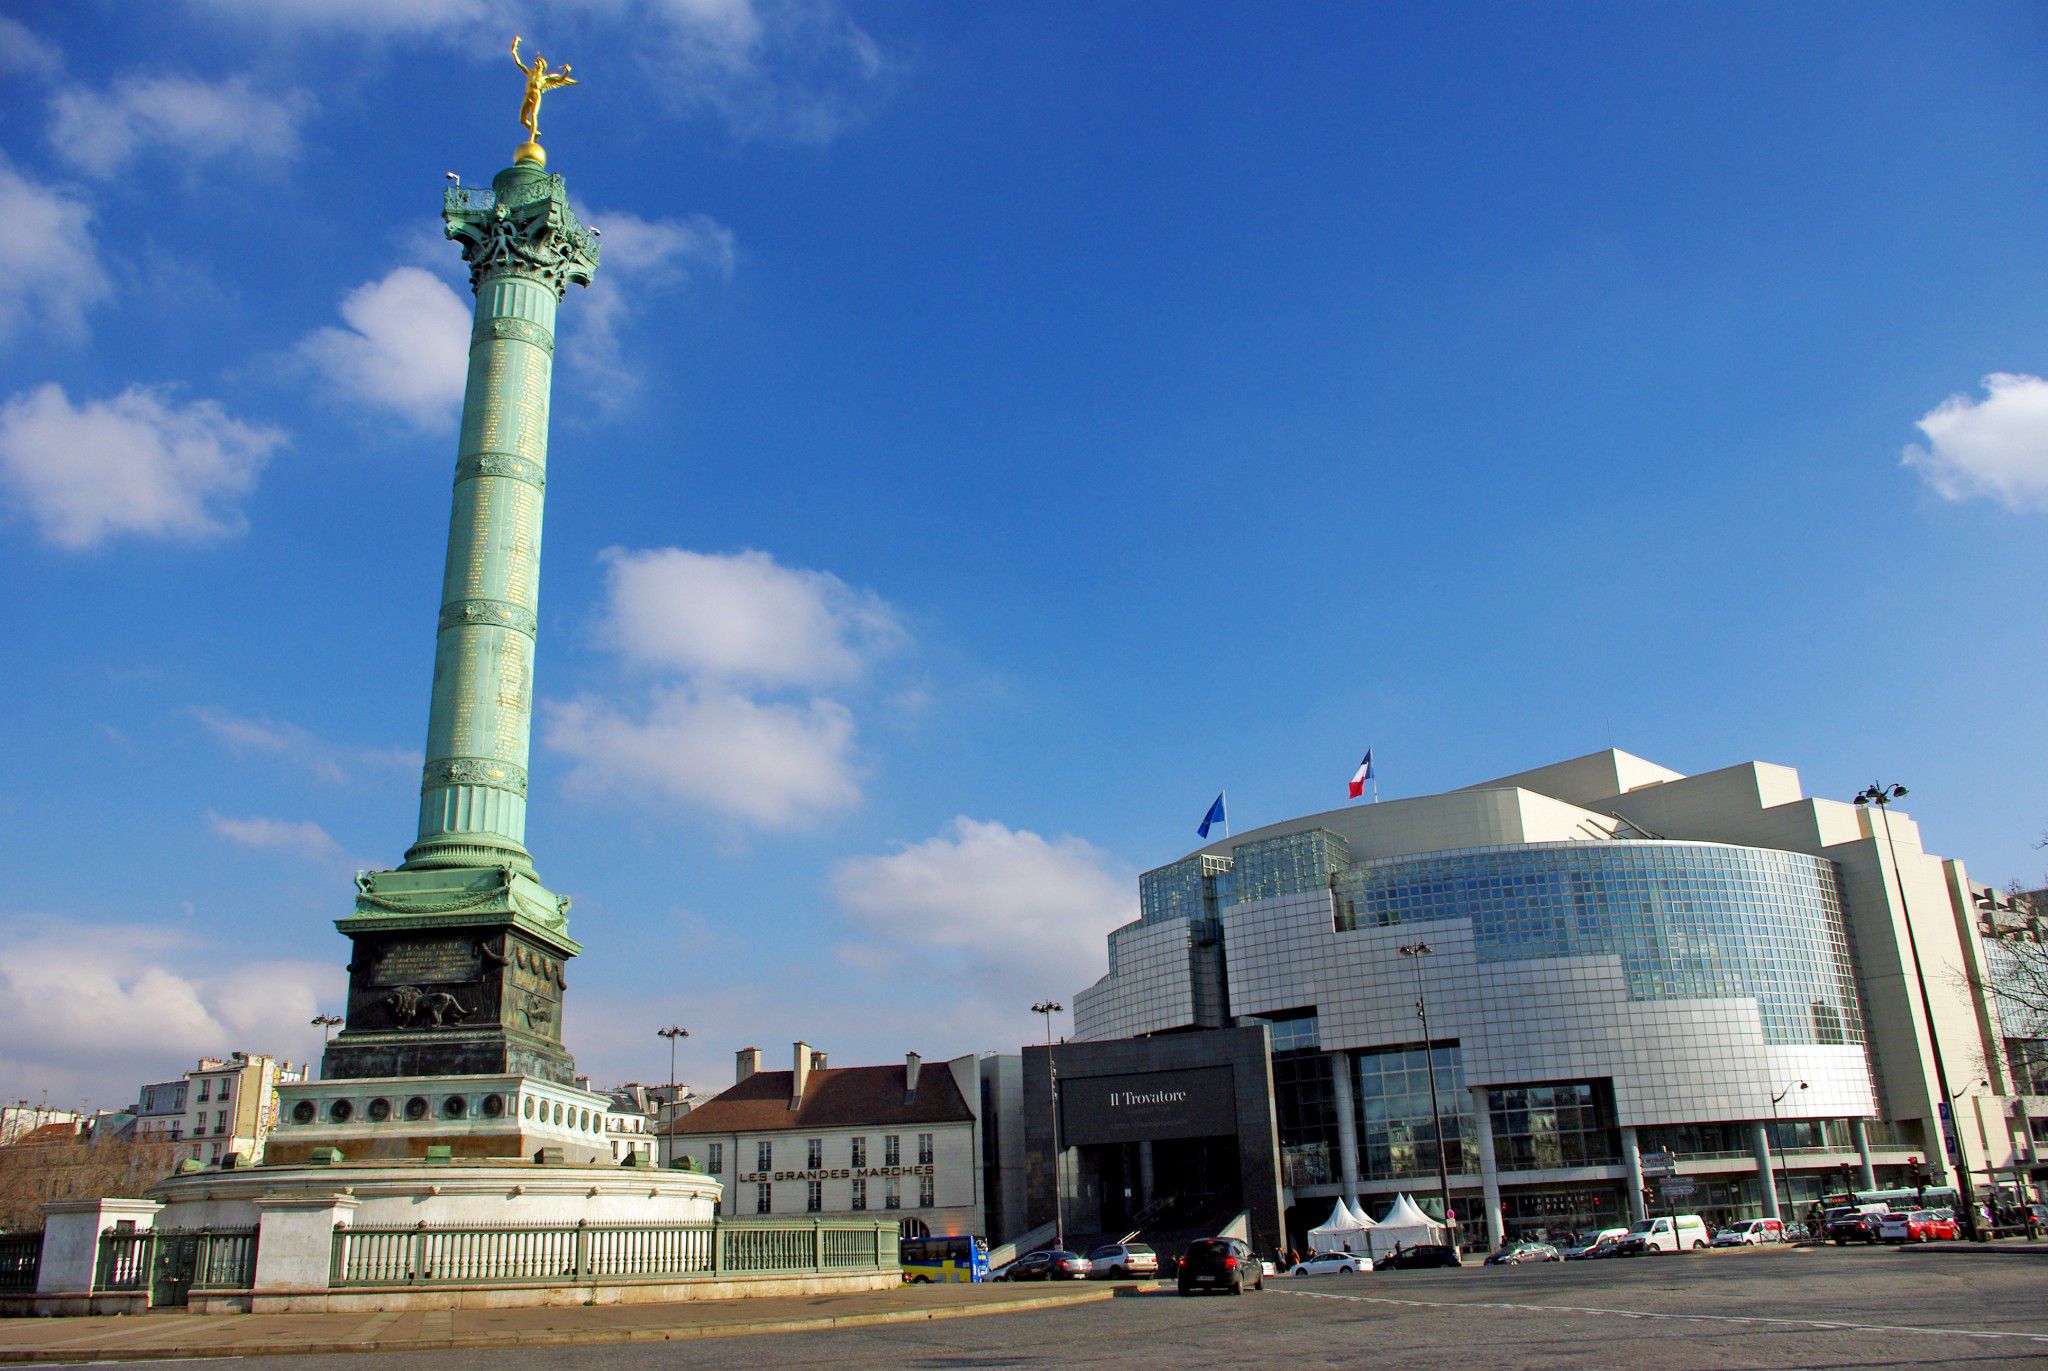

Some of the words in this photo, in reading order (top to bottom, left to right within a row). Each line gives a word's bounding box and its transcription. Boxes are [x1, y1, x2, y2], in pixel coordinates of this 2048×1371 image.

[1110, 1093, 1119, 1106] Il
[1122, 1090, 1187, 1105] Trovatore
[740, 1172, 768, 1183] LES
[774, 1168, 850, 1182] GRANDES
[857, 1165, 934, 1177] MARCHES
[1524, 1195, 1585, 1205] LIBRAIRIE
